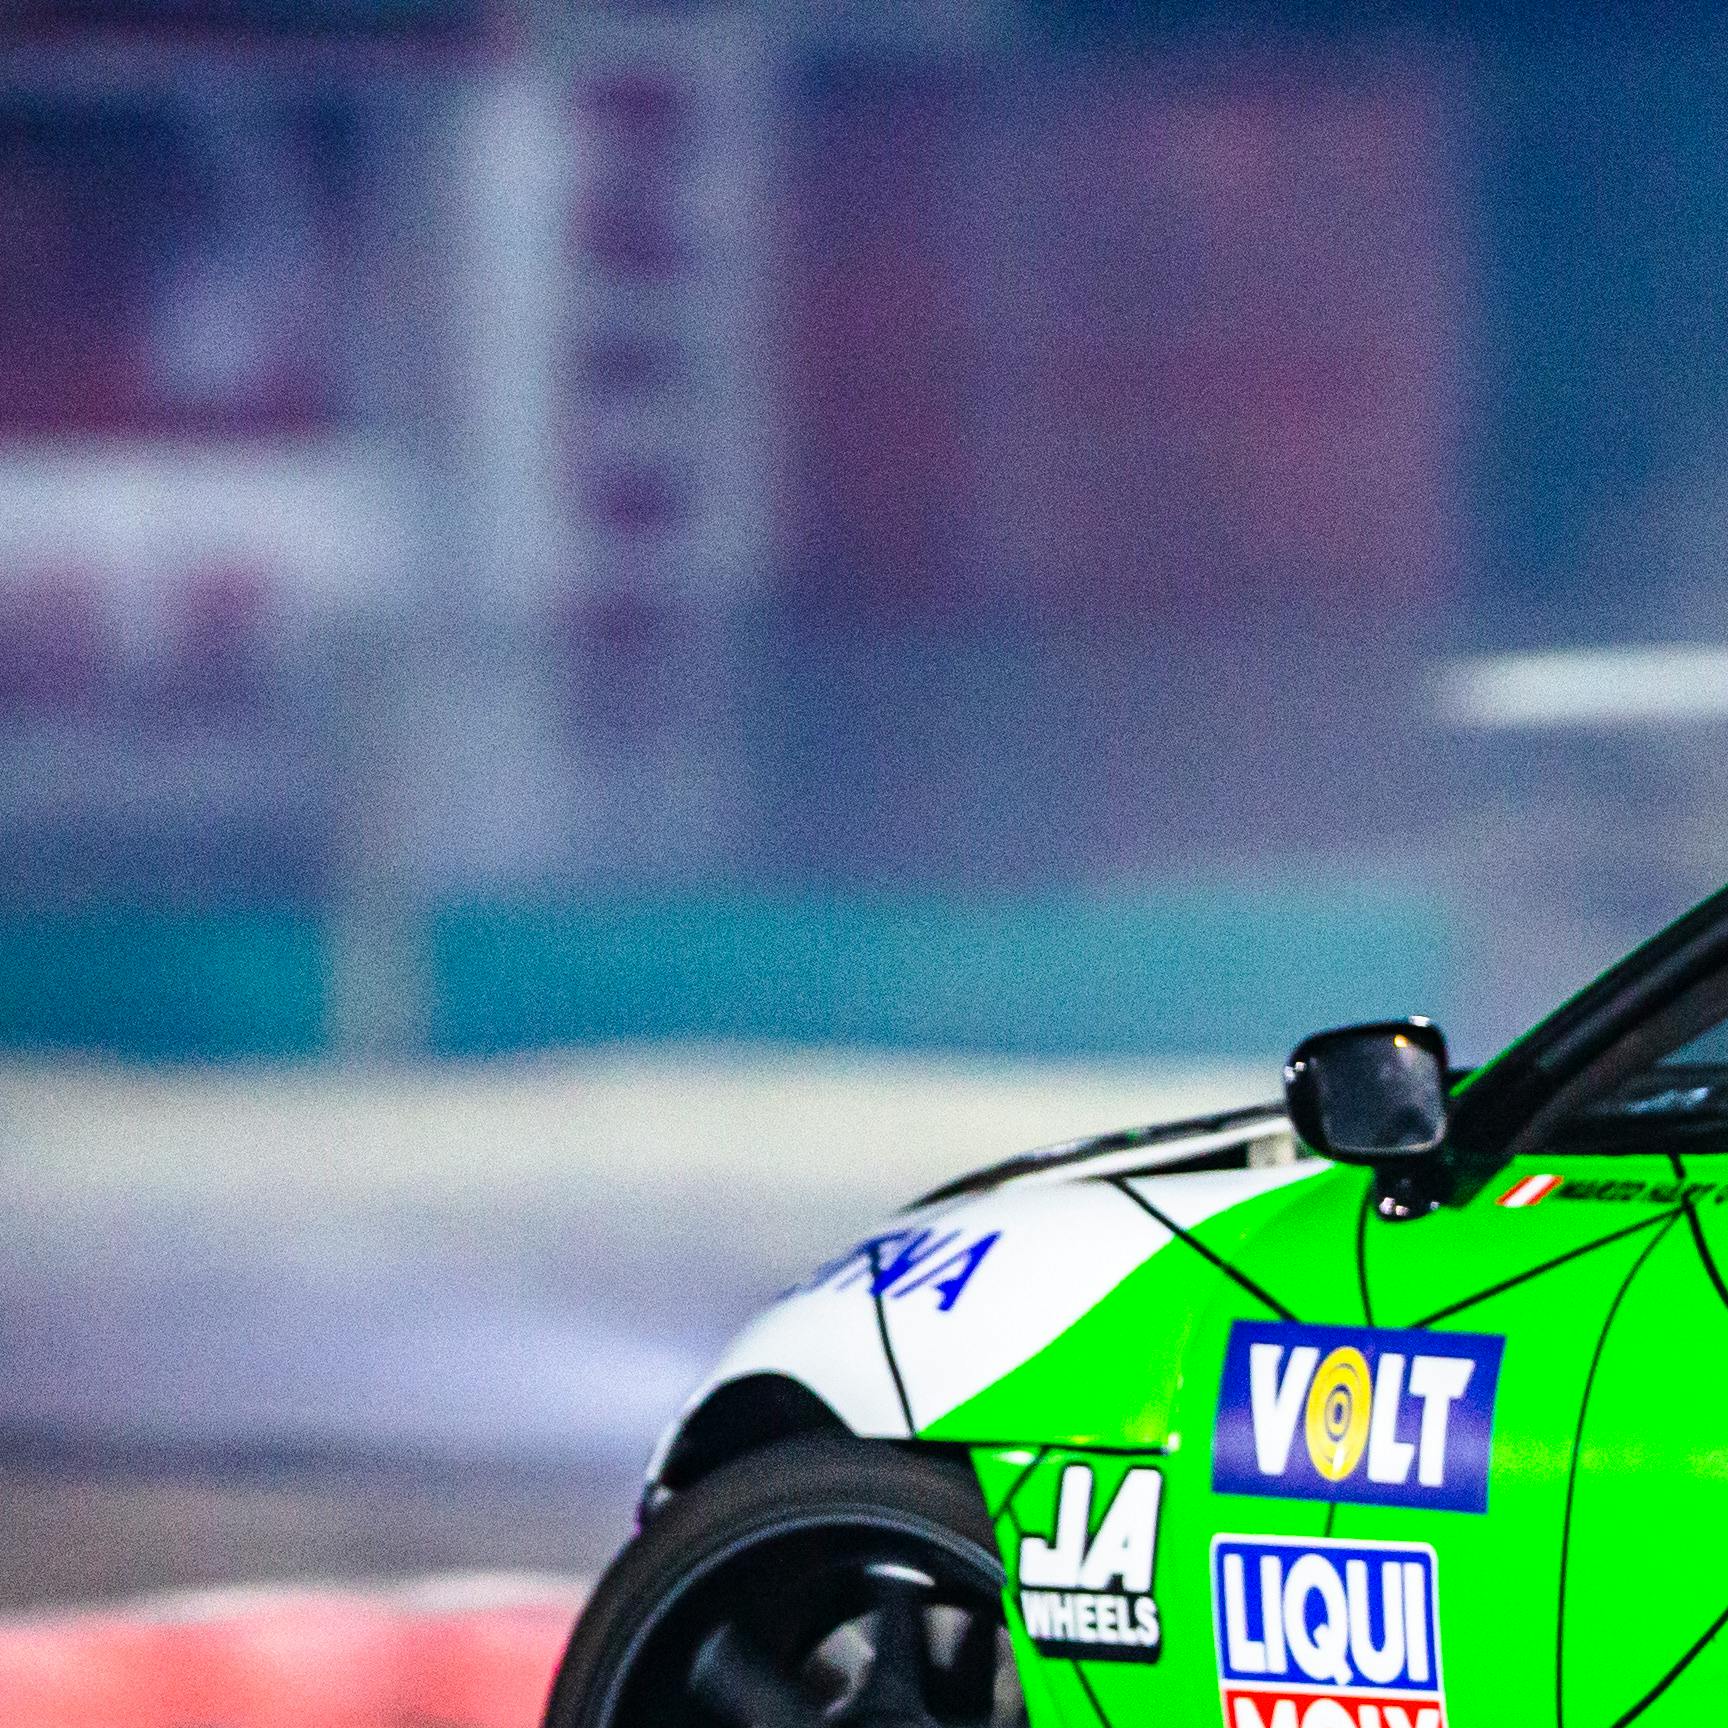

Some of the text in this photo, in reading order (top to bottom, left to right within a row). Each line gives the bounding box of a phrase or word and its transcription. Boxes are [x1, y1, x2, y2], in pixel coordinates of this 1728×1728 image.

[1249, 1342, 1476, 1488] VOLT
[1018, 1465, 1163, 1592] JA
[1022, 1592, 1161, 1647] WHEELS
[1224, 1552, 1435, 1686] LIQUI
